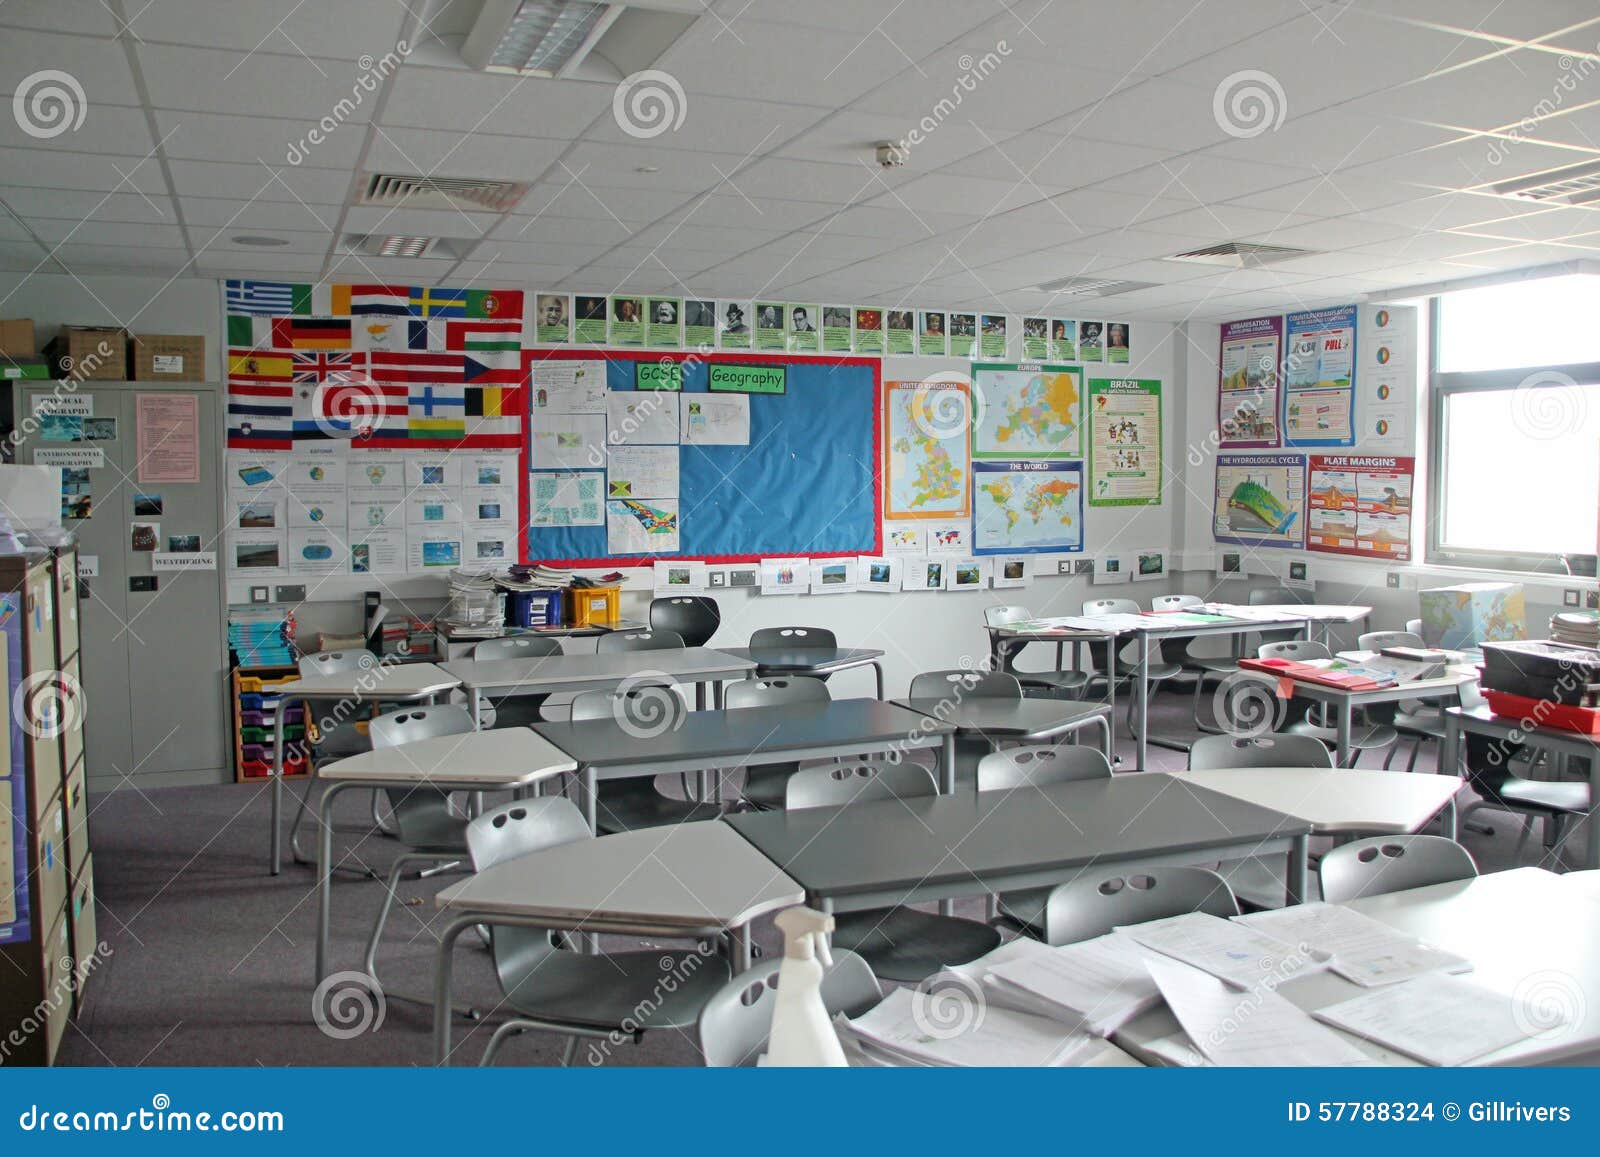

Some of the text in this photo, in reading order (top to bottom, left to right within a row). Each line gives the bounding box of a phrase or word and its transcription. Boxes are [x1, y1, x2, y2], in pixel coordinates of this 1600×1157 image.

[1325, 339, 1342, 351] PULL
[640, 366, 783, 388] GCSE Geography
[1110, 380, 1140, 389] BRAZIL
[1323, 457, 1396, 467] PLATE MARGINS
[155, 558, 214, 566] WEATHERING
